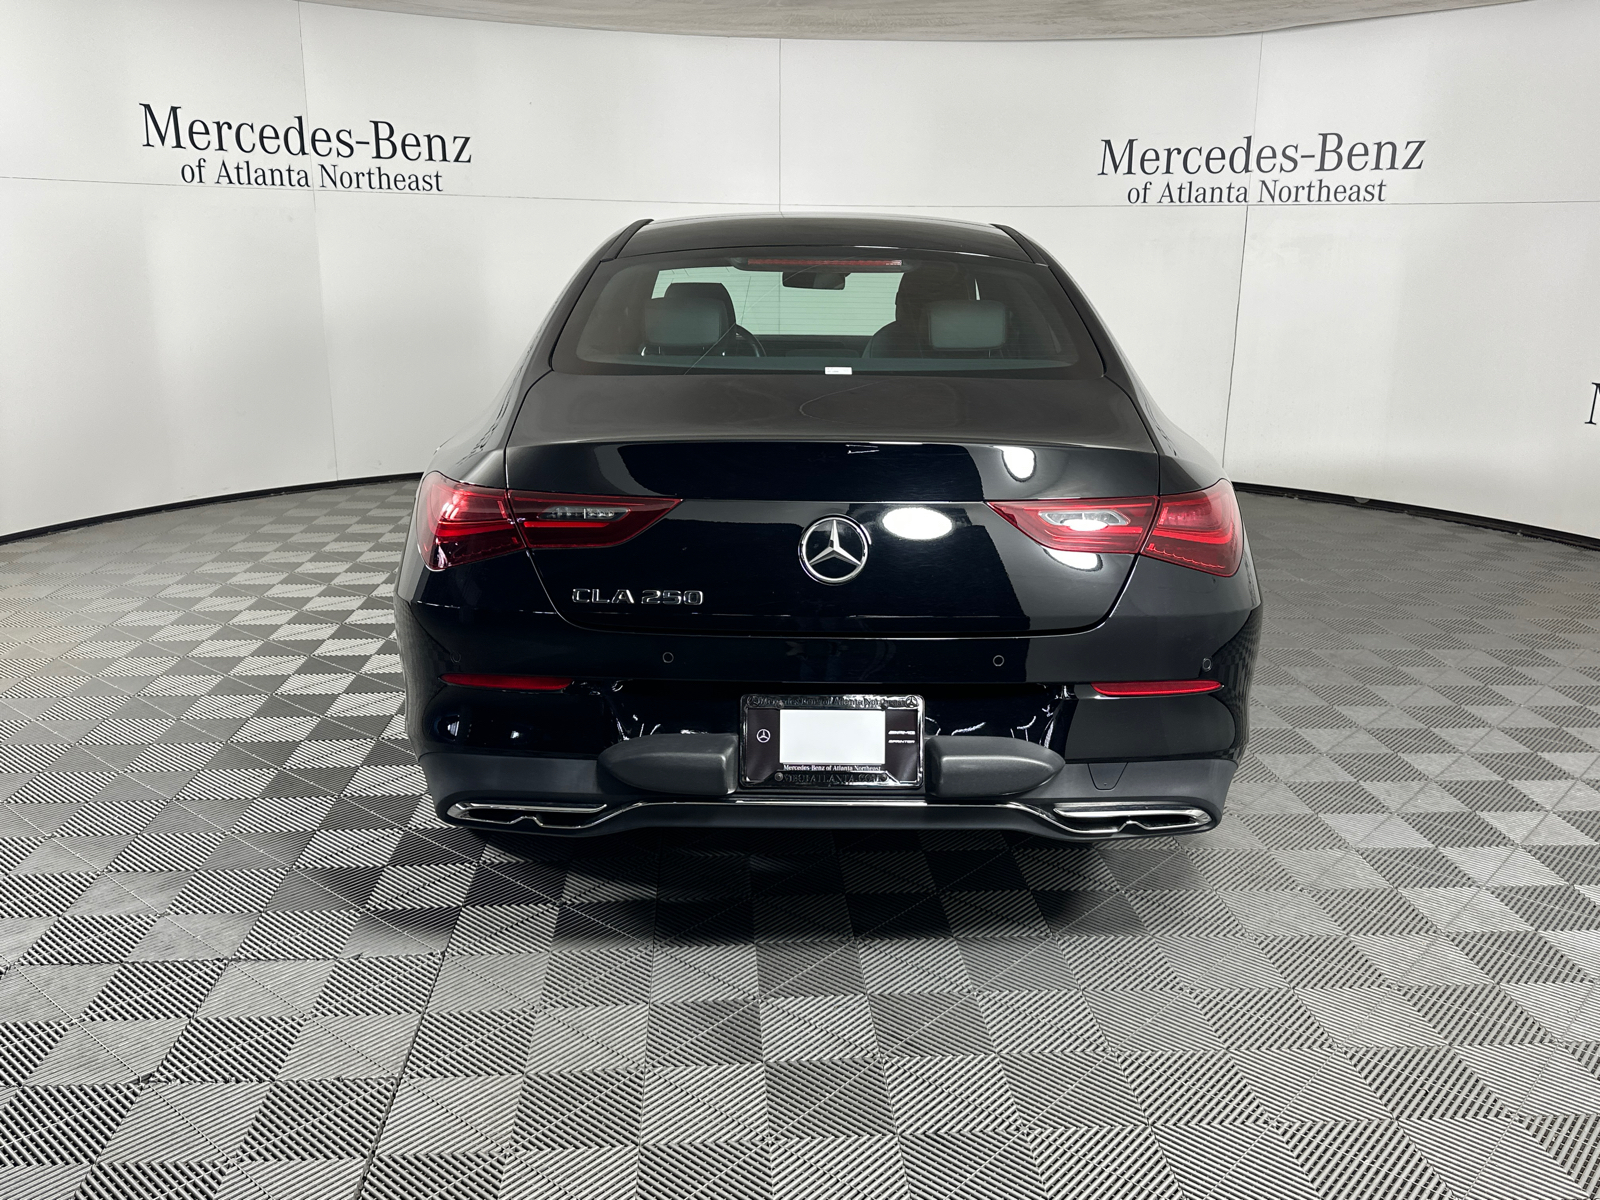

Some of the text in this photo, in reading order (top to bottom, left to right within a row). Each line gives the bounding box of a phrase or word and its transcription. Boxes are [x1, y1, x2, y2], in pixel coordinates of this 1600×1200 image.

[138, 101, 473, 164] Mercedes-Benz
[1097, 131, 1426, 176] Mercedes-Benz
[180, 157, 444, 193] of Atlanta Northeast
[1127, 178, 1387, 204] of Atlanta Northeast
[571, 588, 704, 606] CLA 250
